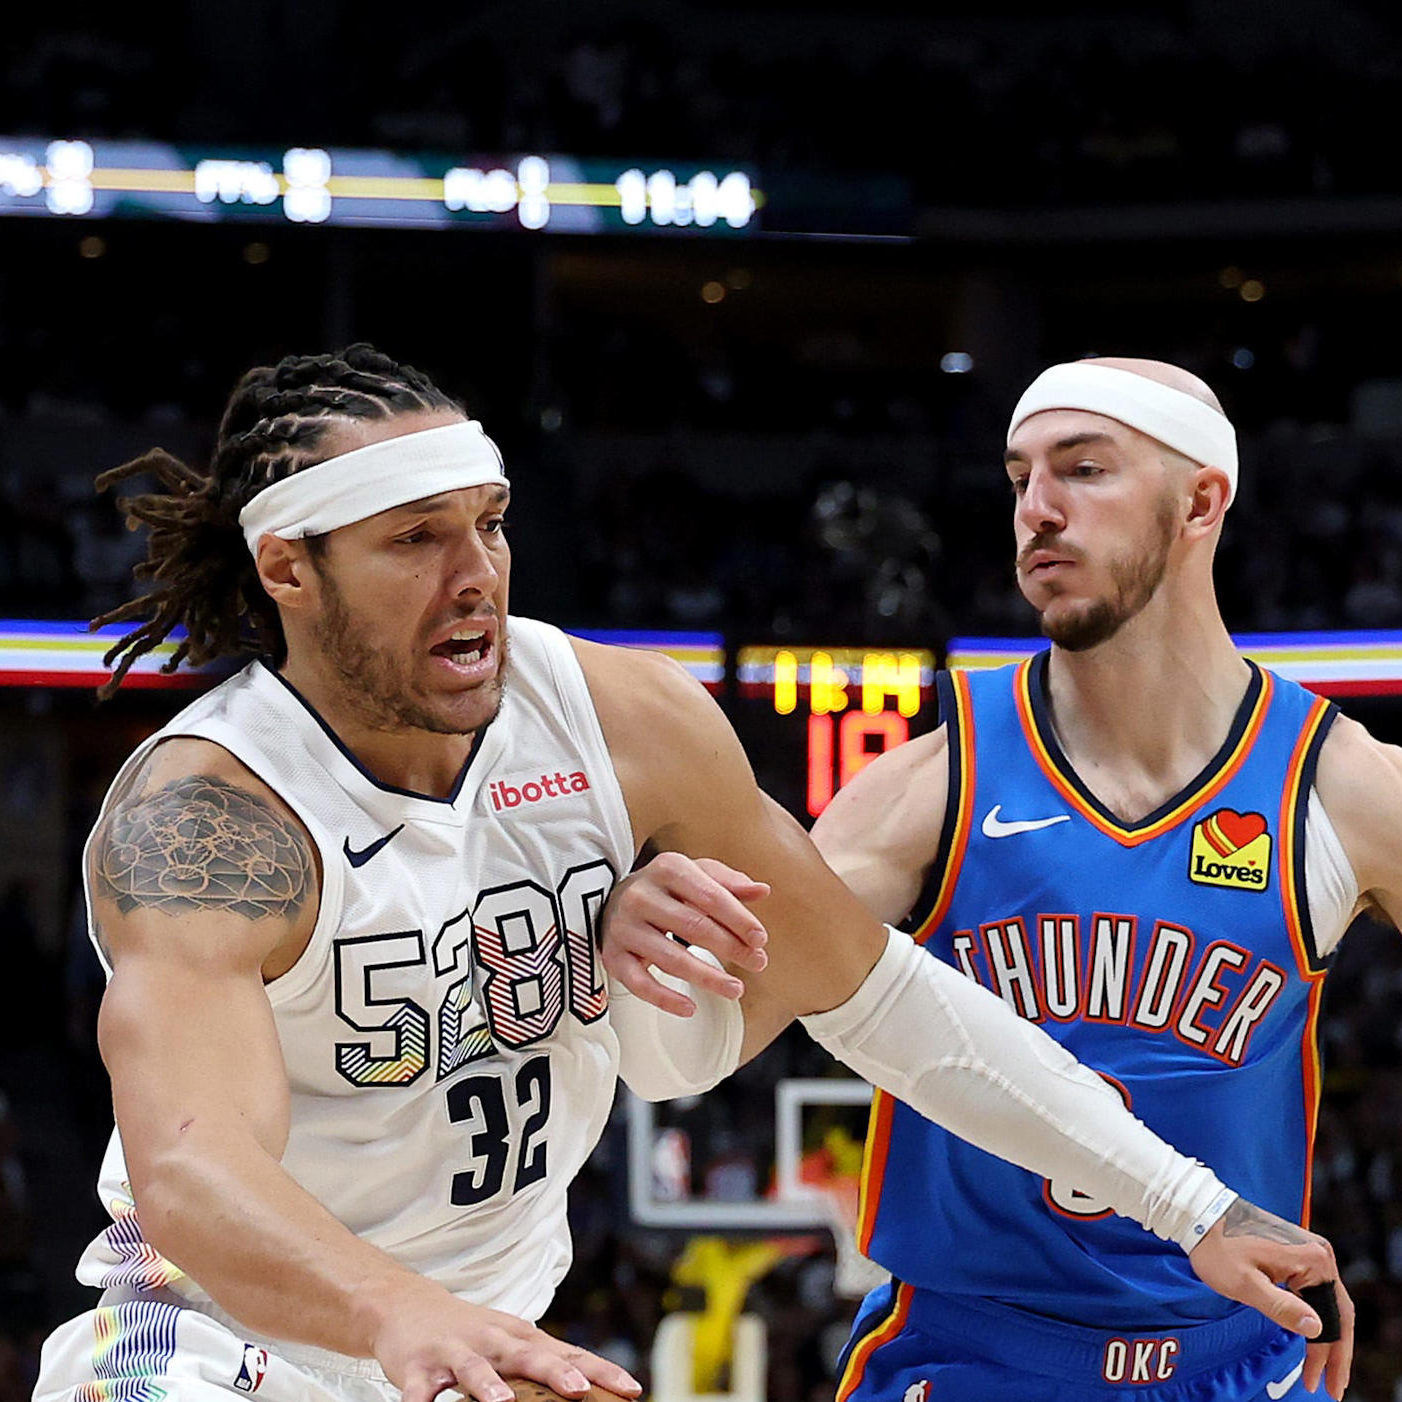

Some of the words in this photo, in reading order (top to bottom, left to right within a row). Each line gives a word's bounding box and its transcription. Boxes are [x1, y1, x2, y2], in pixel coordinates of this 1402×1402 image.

[489, 771, 590, 812] ibotta
[334, 858, 616, 1087] 5280
[446, 1054, 551, 1206] 32
[1102, 1336, 1180, 1384] OKC
